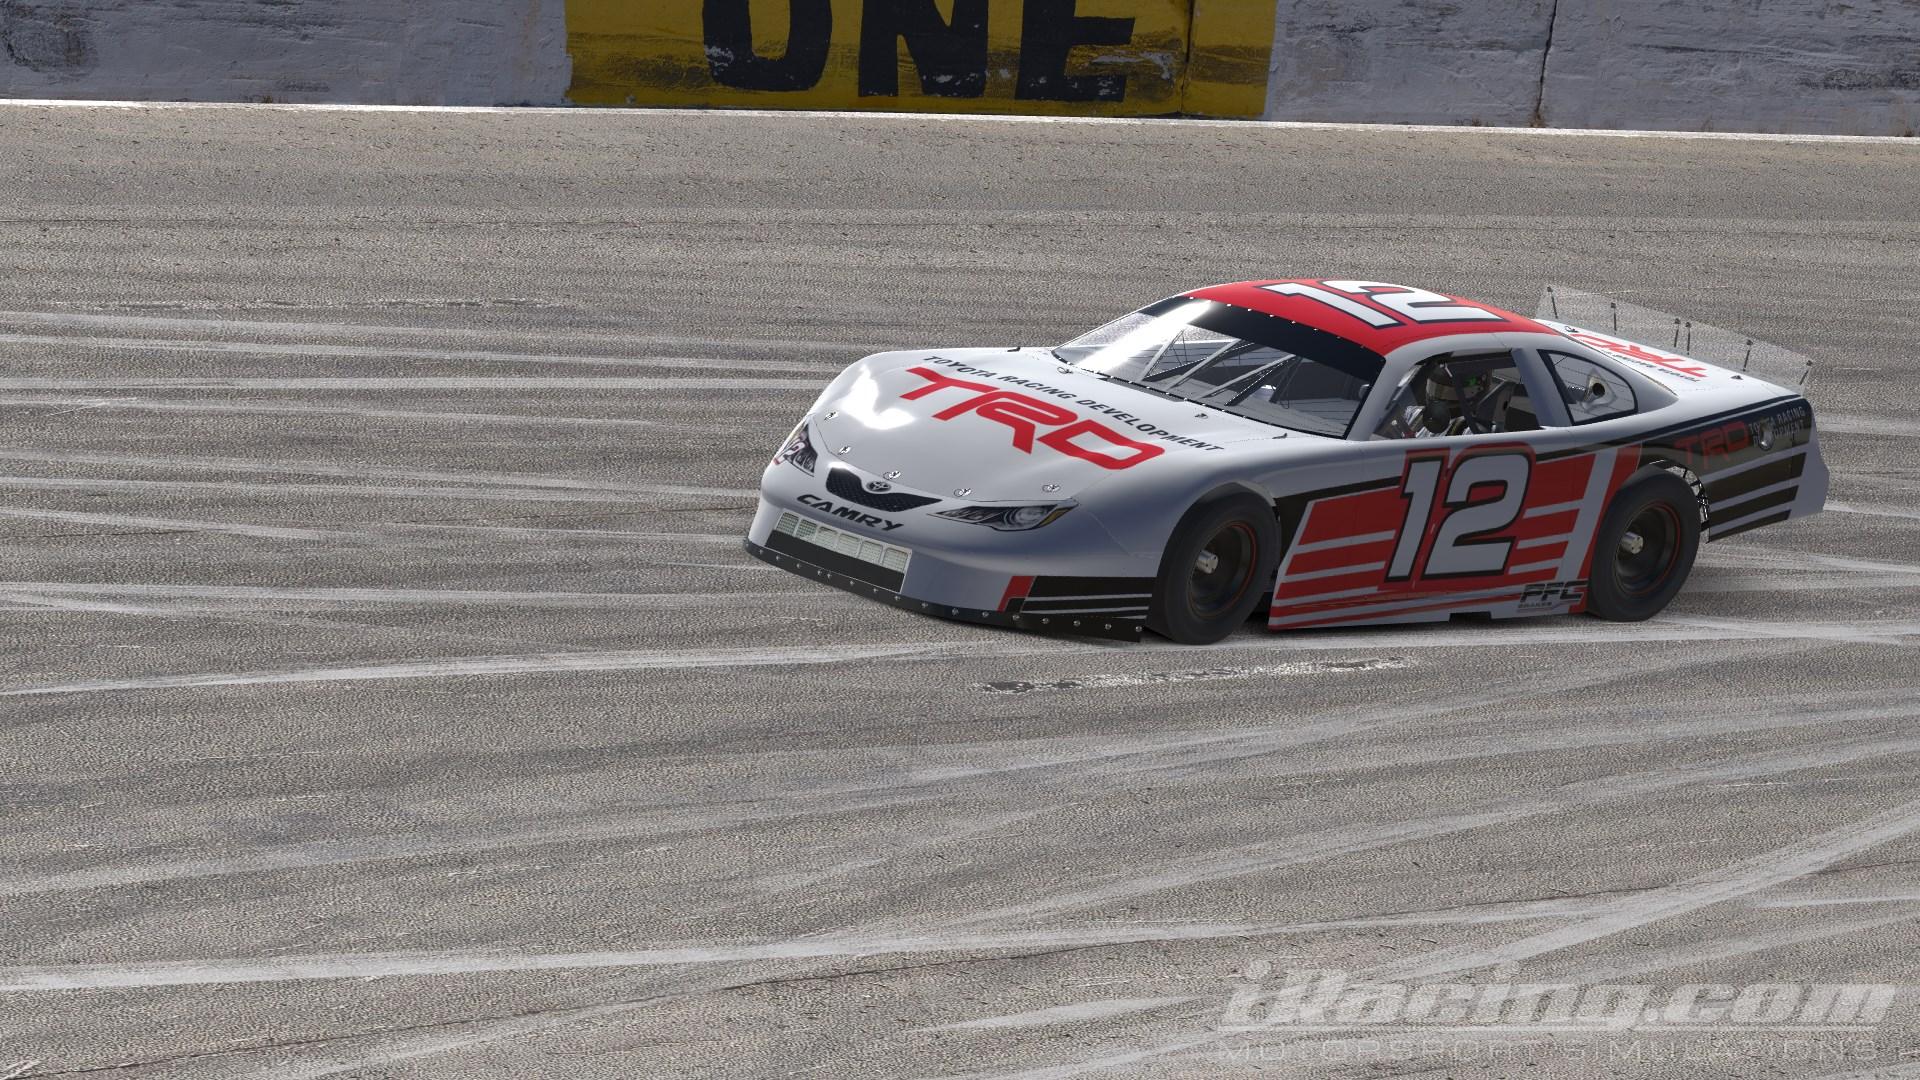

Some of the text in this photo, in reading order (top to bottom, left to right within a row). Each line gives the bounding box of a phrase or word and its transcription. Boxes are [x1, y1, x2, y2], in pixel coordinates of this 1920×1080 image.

[1254, 280, 1510, 330] 12
[899, 366, 1166, 471] TRD
[924, 355, 1225, 451] TOYOTA RACING DEVELOPMENT
[1674, 421, 1749, 471] TRD
[796, 494, 905, 532] CAMRY
[1384, 449, 1533, 583] 12
[1520, 581, 1589, 603] PFC
